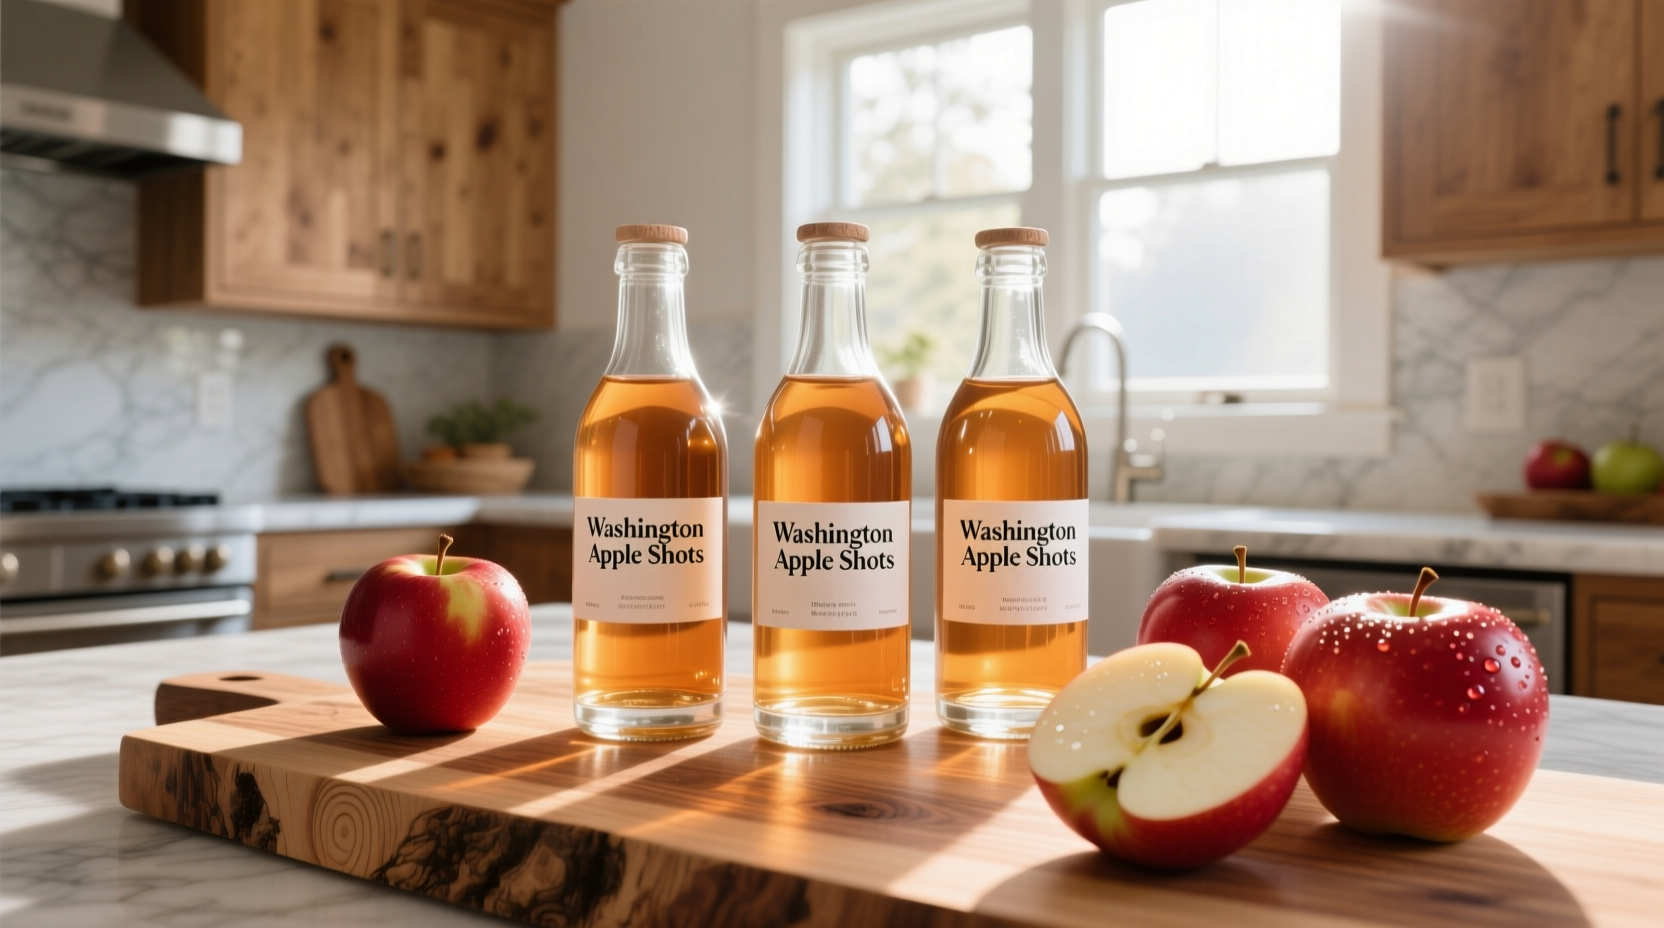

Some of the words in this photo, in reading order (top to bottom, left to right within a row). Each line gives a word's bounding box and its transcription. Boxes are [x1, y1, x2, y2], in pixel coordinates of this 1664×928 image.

[587, 516, 704, 544] Washington
[773, 521, 894, 549] Washington
[960, 519, 1076, 546] Washington
[588, 543, 642, 570] Apple
[647, 544, 704, 564] Shots
[774, 548, 834, 576] Apple
[839, 549, 895, 570] Shots
[961, 545, 1021, 572] Apple
[1026, 546, 1077, 566] Shots
